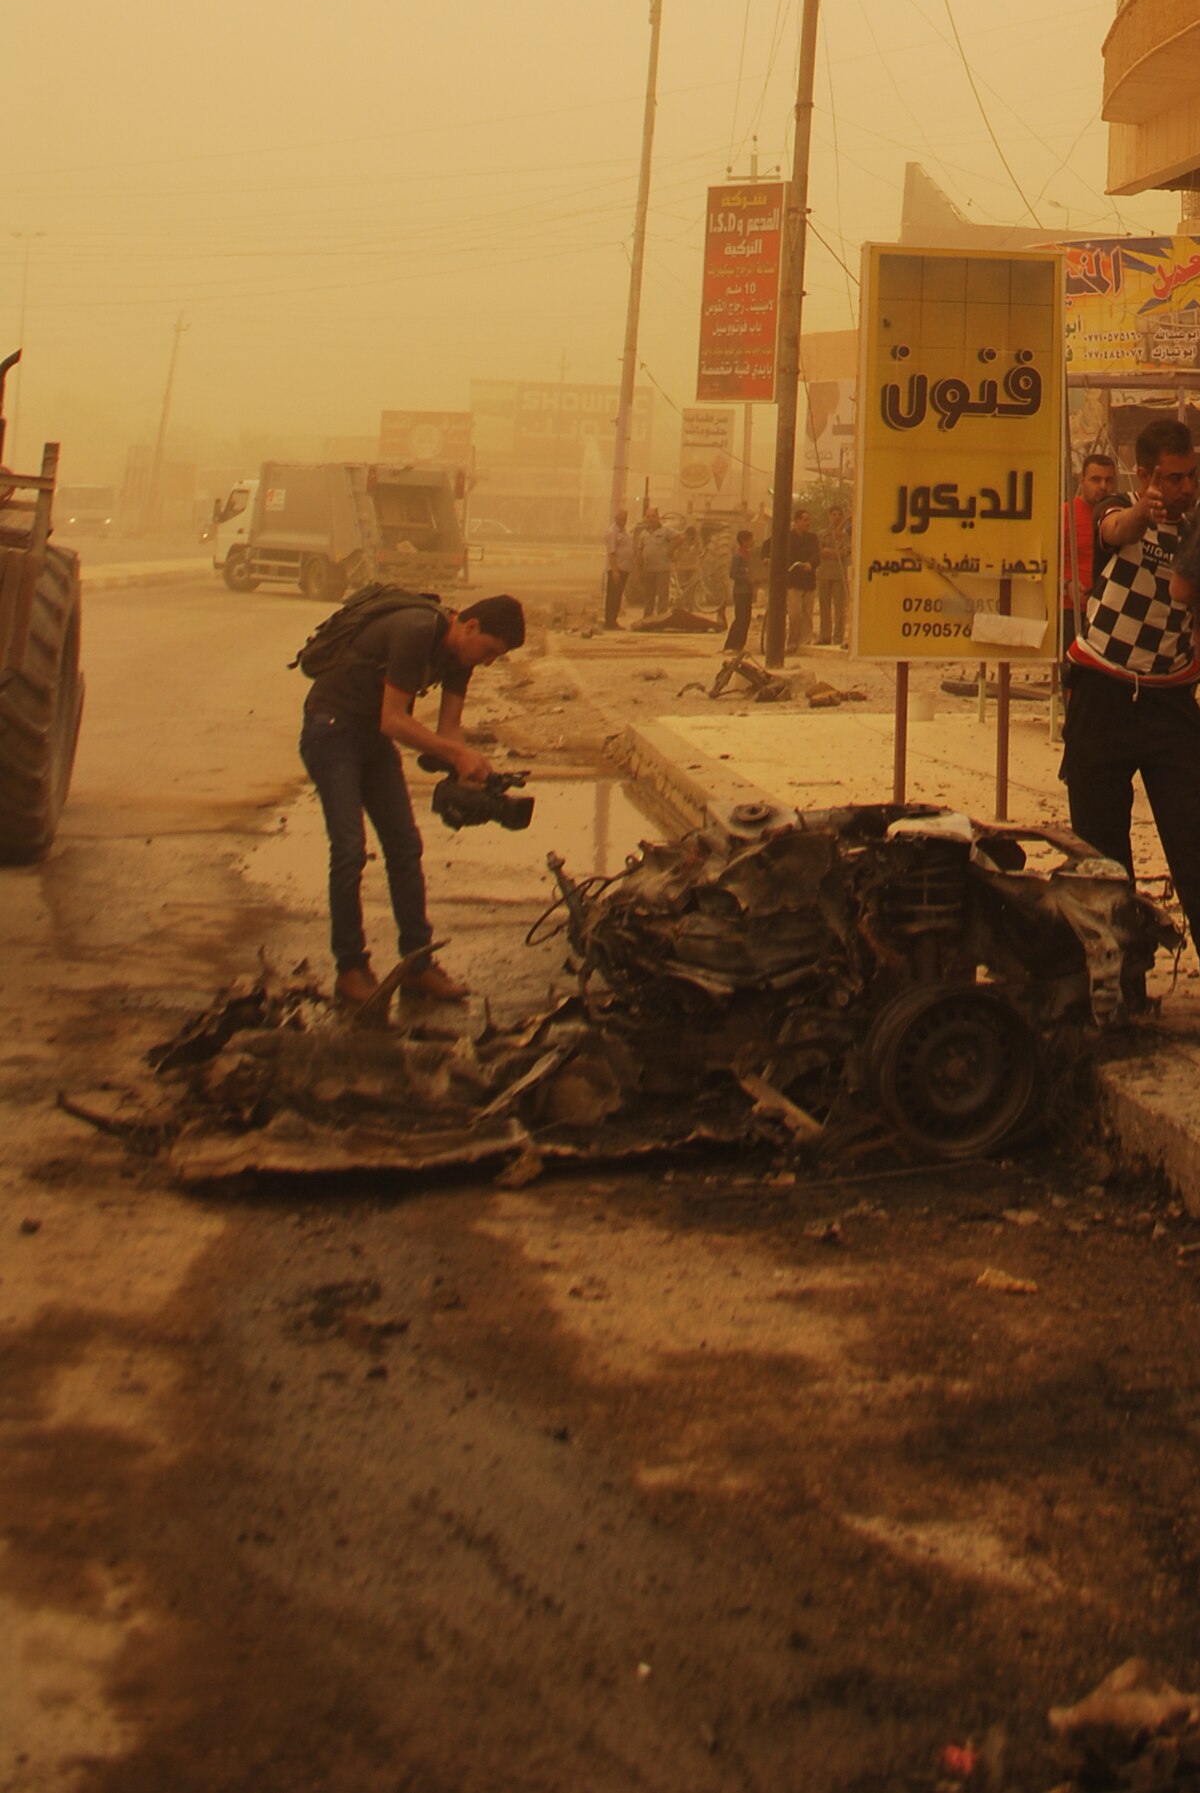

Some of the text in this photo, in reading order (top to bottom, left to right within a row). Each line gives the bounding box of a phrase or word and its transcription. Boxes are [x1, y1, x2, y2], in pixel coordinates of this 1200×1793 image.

[745, 281, 757, 294] 10
[881, 343, 1043, 431] فنون
[891, 471, 1034, 535] للديكور
[867, 556, 923, 582] تصميم
[1001, 557, 1048, 582] تجهيز
[901, 622, 973, 638] 0790576
